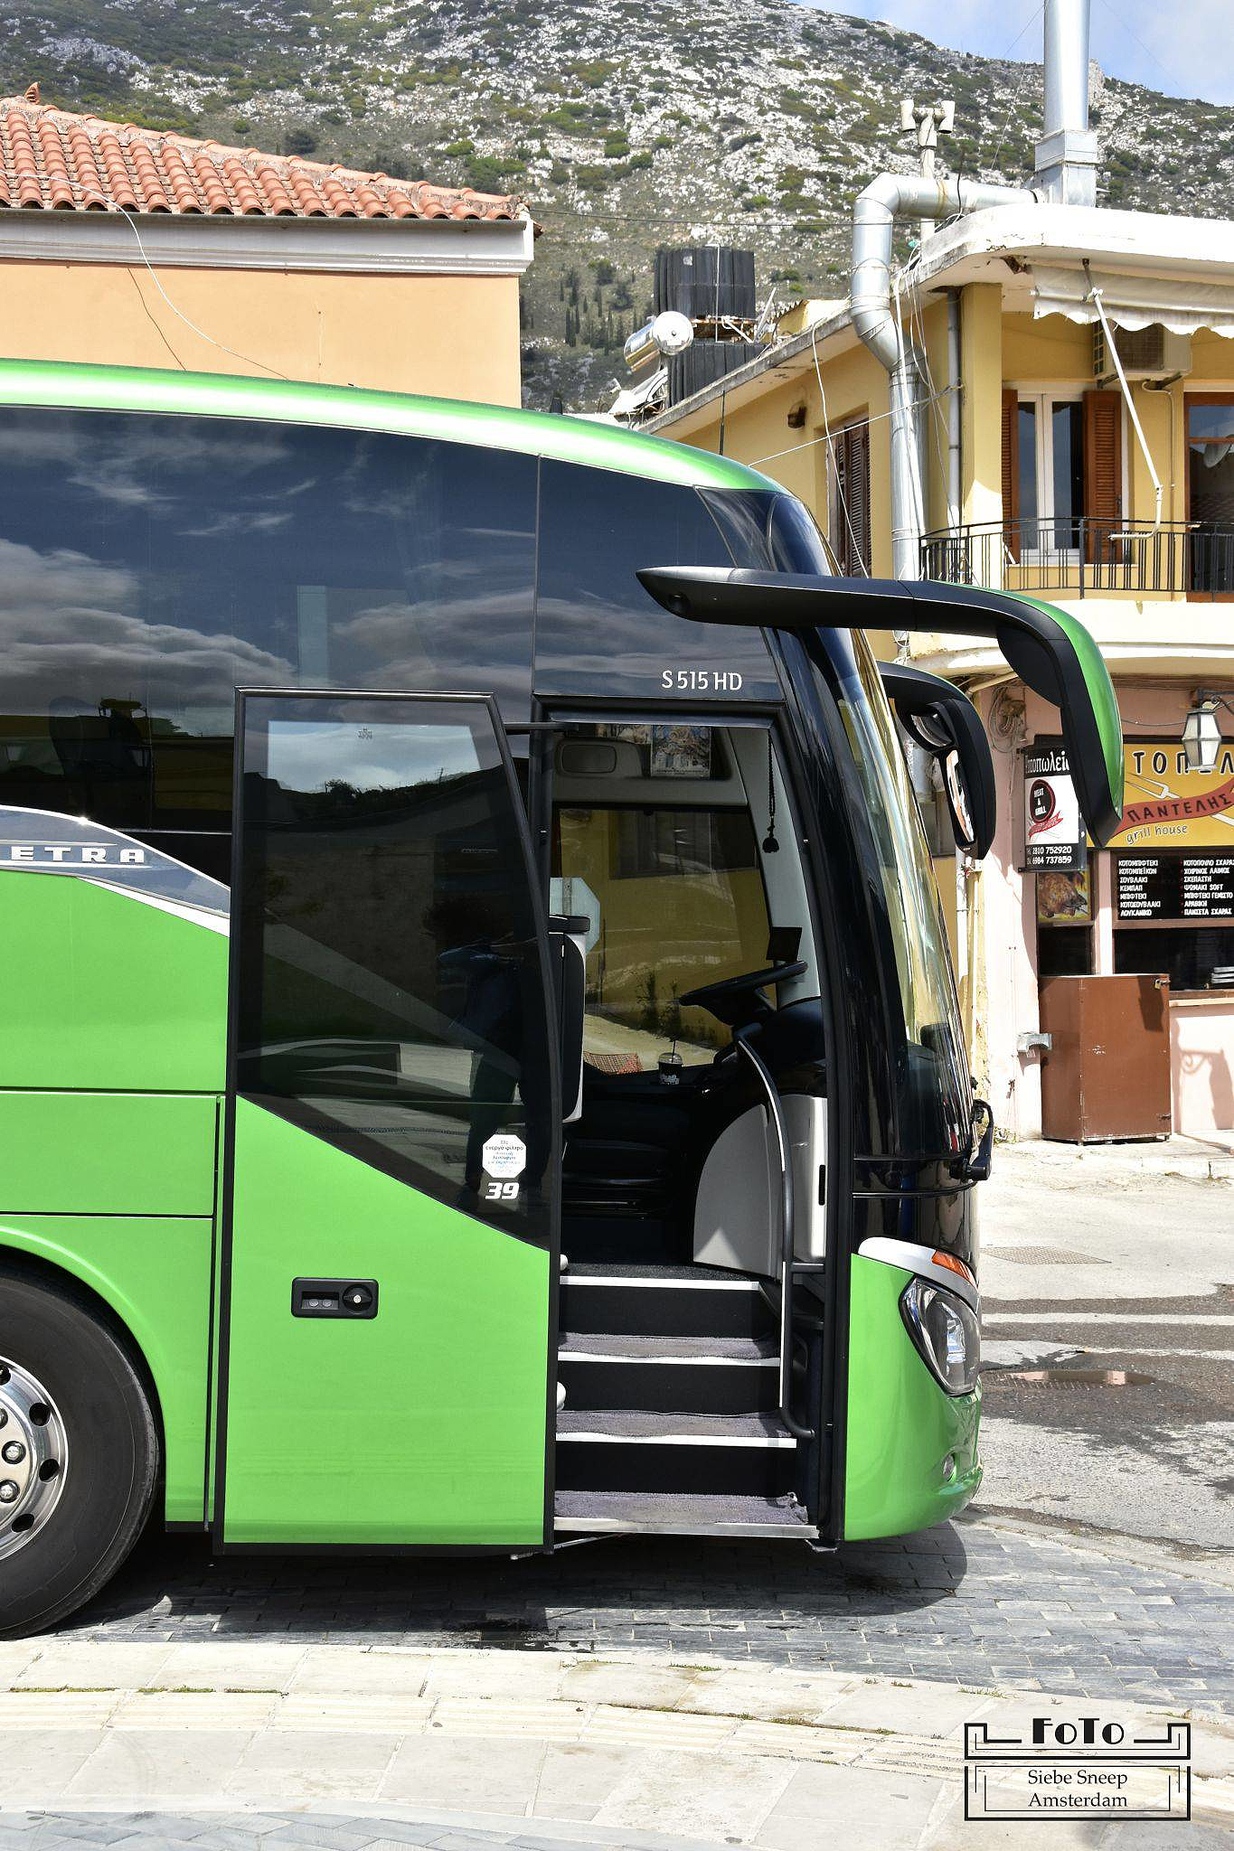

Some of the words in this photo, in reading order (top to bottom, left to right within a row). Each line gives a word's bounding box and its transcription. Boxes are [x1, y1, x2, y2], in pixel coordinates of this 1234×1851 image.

[661, 669, 674, 689] S
[677, 670, 709, 690] 515
[712, 671, 743, 691] HD
[1127, 793, 1232, 822] ΠΑΝΤΕΛΗΣ
[1126, 827, 1151, 845] grill
[1154, 825, 1188, 837] house
[1045, 845, 1073, 855] 752920
[485, 1182, 520, 1200] 39
